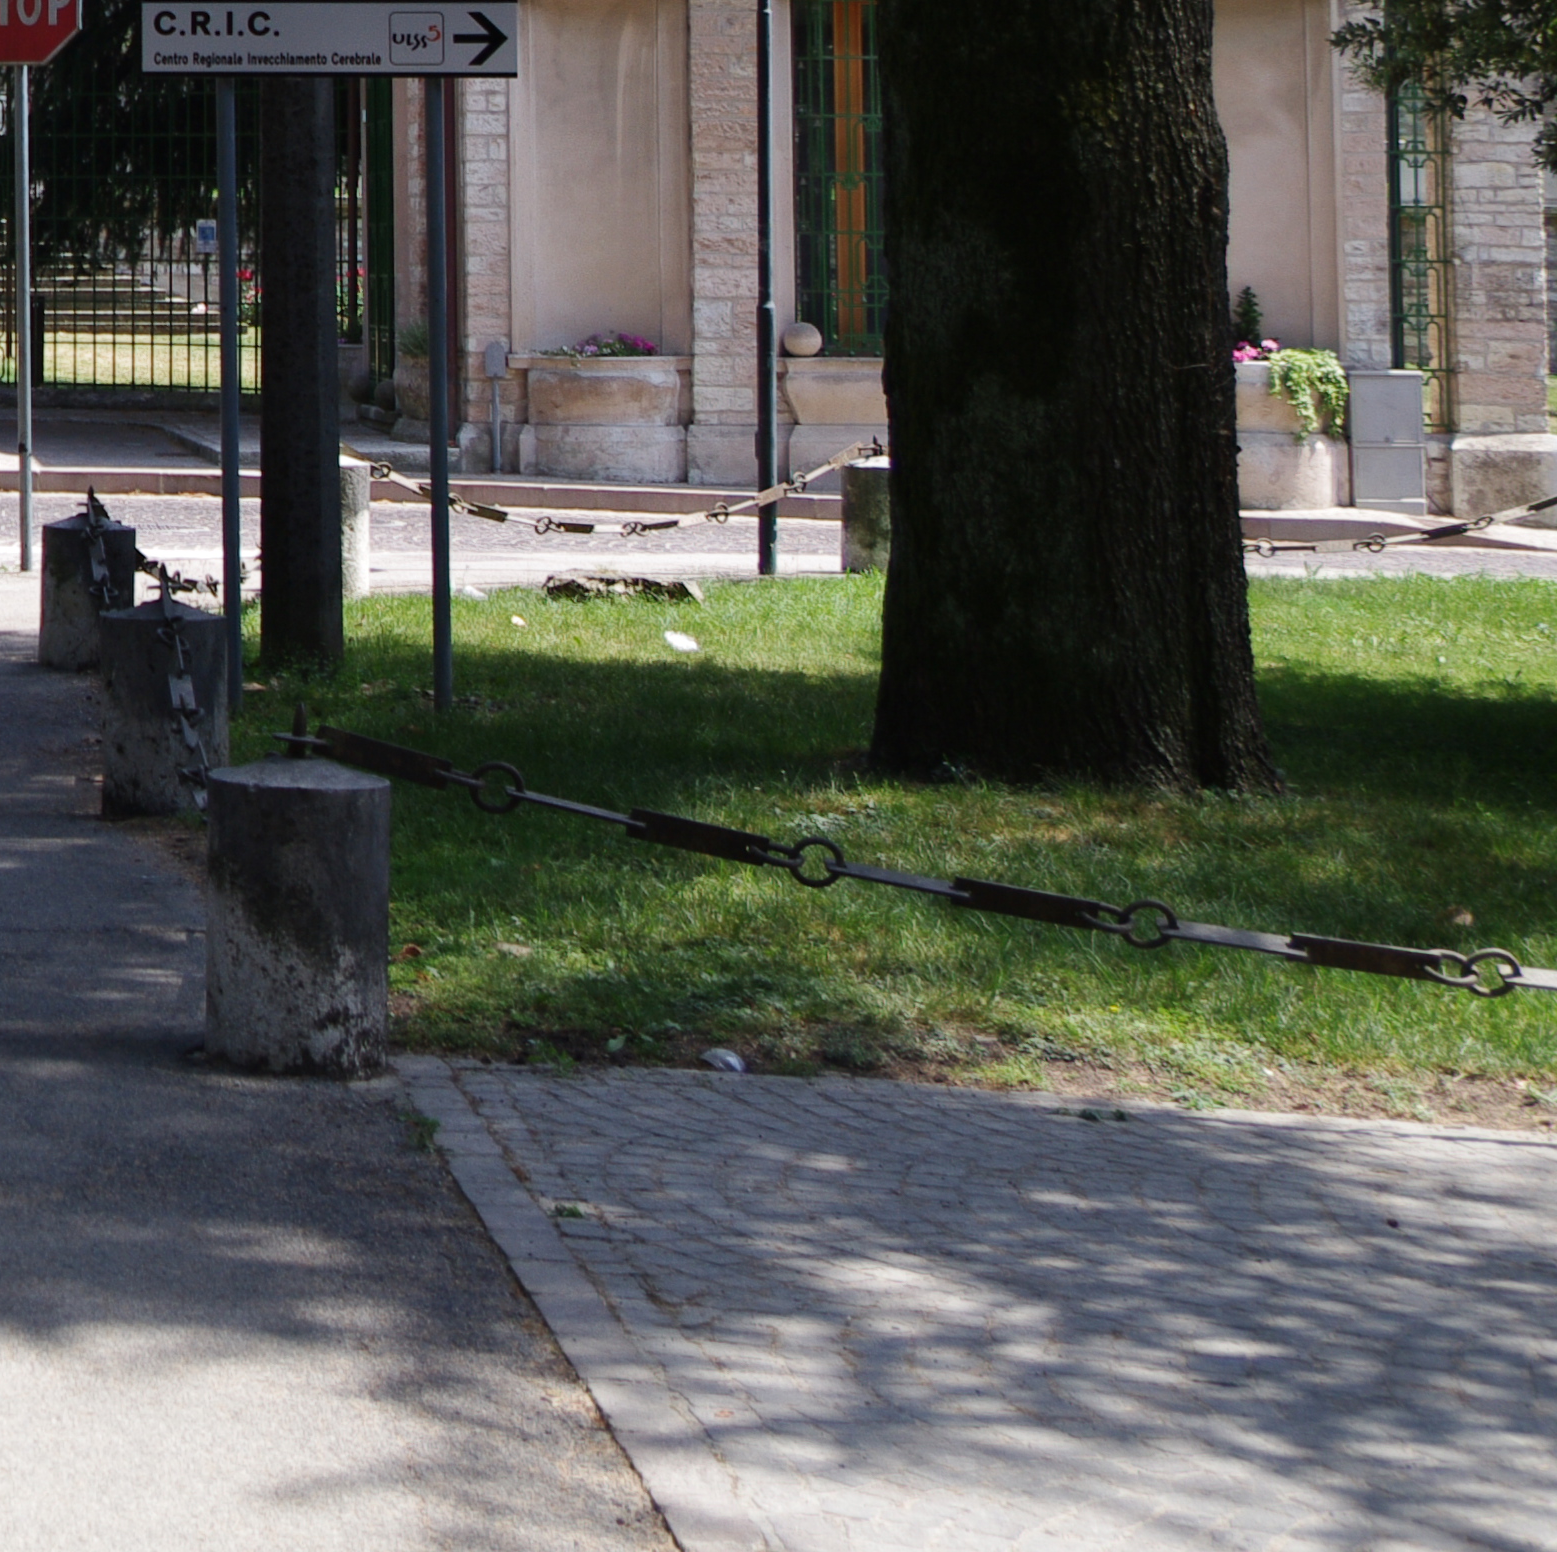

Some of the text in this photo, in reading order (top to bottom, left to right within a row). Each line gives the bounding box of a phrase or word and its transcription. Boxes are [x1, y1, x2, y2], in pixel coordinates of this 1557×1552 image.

[153, 10, 281, 36] C.R.I.C.
[153, 52, 382, 68] Centro Regionale Invecchiamento Cerebrale
